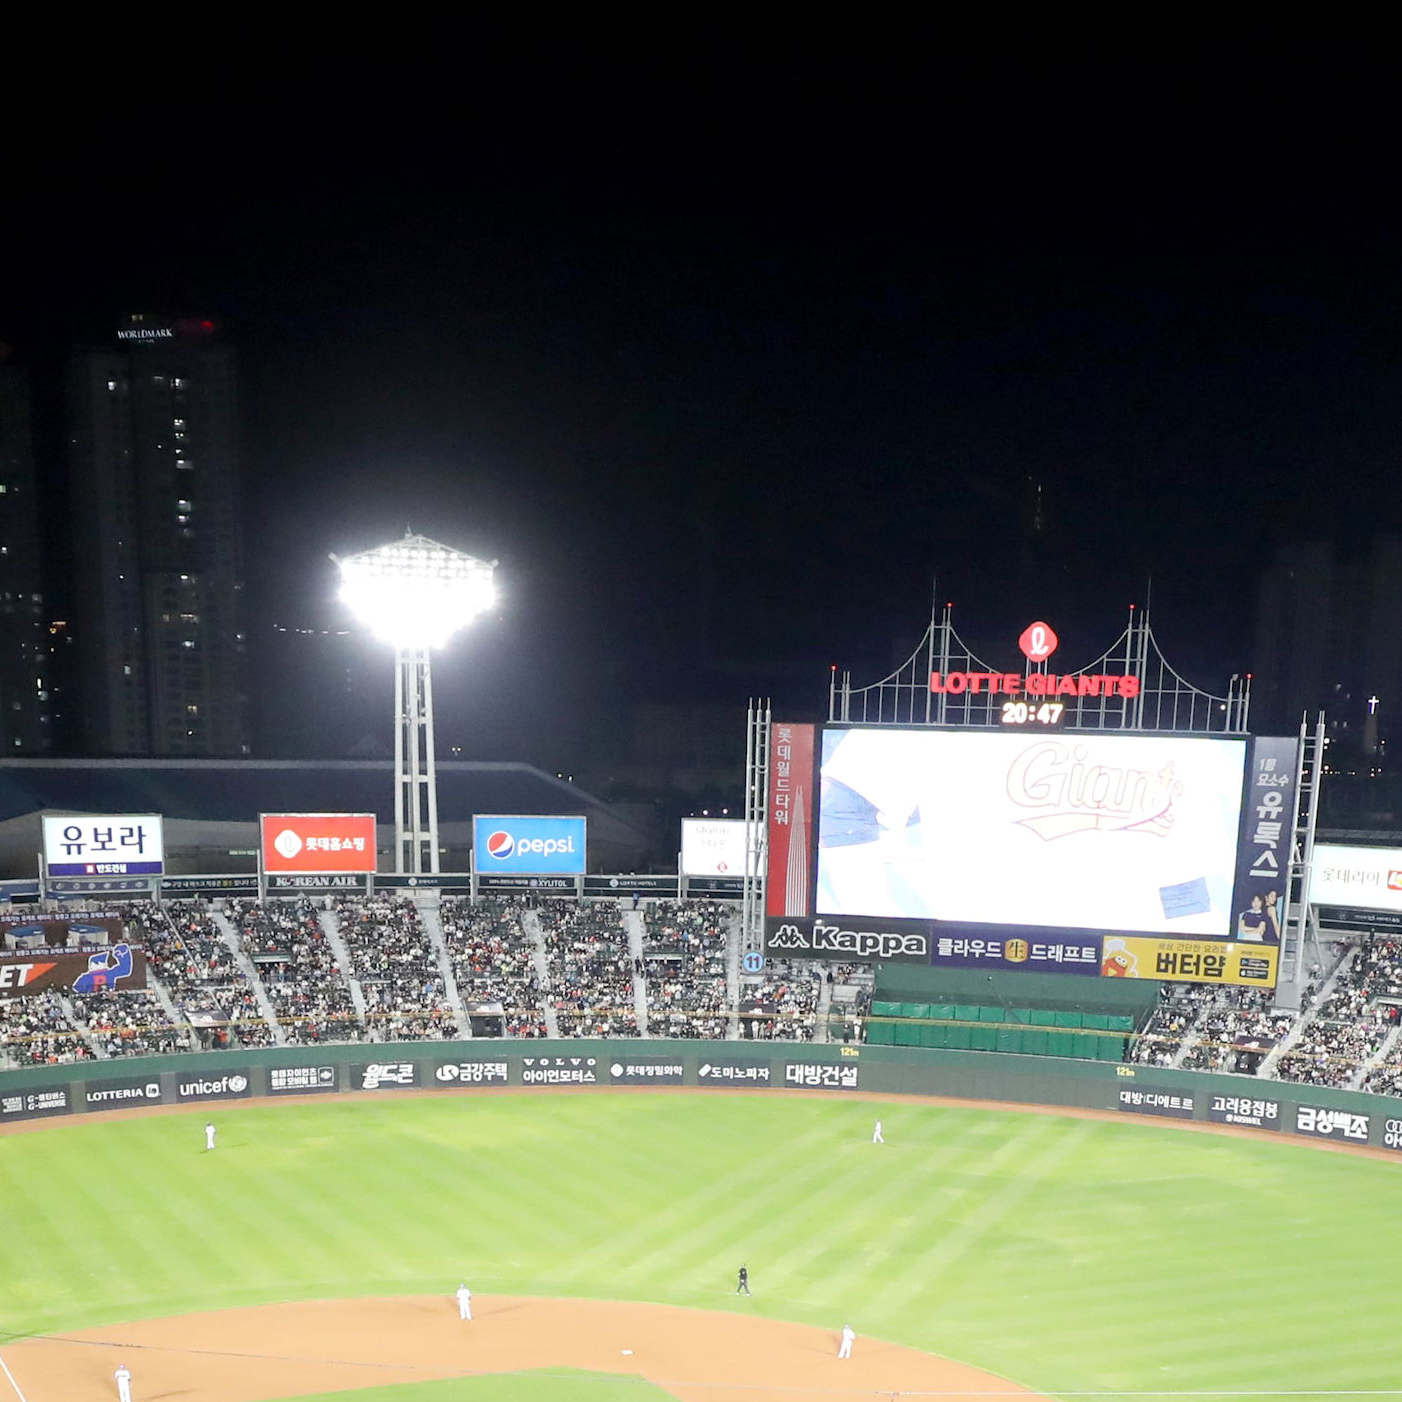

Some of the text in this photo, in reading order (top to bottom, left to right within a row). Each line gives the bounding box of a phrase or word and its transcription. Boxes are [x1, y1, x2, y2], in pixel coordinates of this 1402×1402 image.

[930, 672, 1140, 698] LOTTE GIANTS
[1002, 702, 1063, 725] 20:47
[774, 728, 791, 825] 롯데월드타워
[60, 825, 147, 856] 유보라
[305, 836, 365, 852] 롯데홈쇼핑
[1249, 791, 1284, 878] 유록스
[1321, 868, 1381, 887] 롯데리아
[813, 926, 927, 957] Kappa
[937, 937, 1002, 959] 클라우드
[1030, 944, 1098, 964] 드래프트
[746, 955, 761, 970] 11
[1156, 952, 1227, 978] 버터얌
[523, 1058, 597, 1067] VOLVO
[840, 1046, 859, 1057] 121m
[362, 1064, 414, 1089] 월드콘
[460, 1062, 508, 1081] 금강주택
[523, 1069, 596, 1084] 아이언모터스
[626, 1064, 683, 1077] 롯데정밀화학
[711, 1067, 770, 1081] 도미노피자
[786, 1063, 859, 1088] 대방건설
[1116, 1066, 1135, 1077] 121m
[87, 1087, 144, 1102] LOTTERIA
[180, 1075, 228, 1097] unicef
[1120, 1091, 1144, 1105] 대방
[1212, 1096, 1278, 1118] 고려용접봉
[1298, 1106, 1370, 1140] 금성백조
